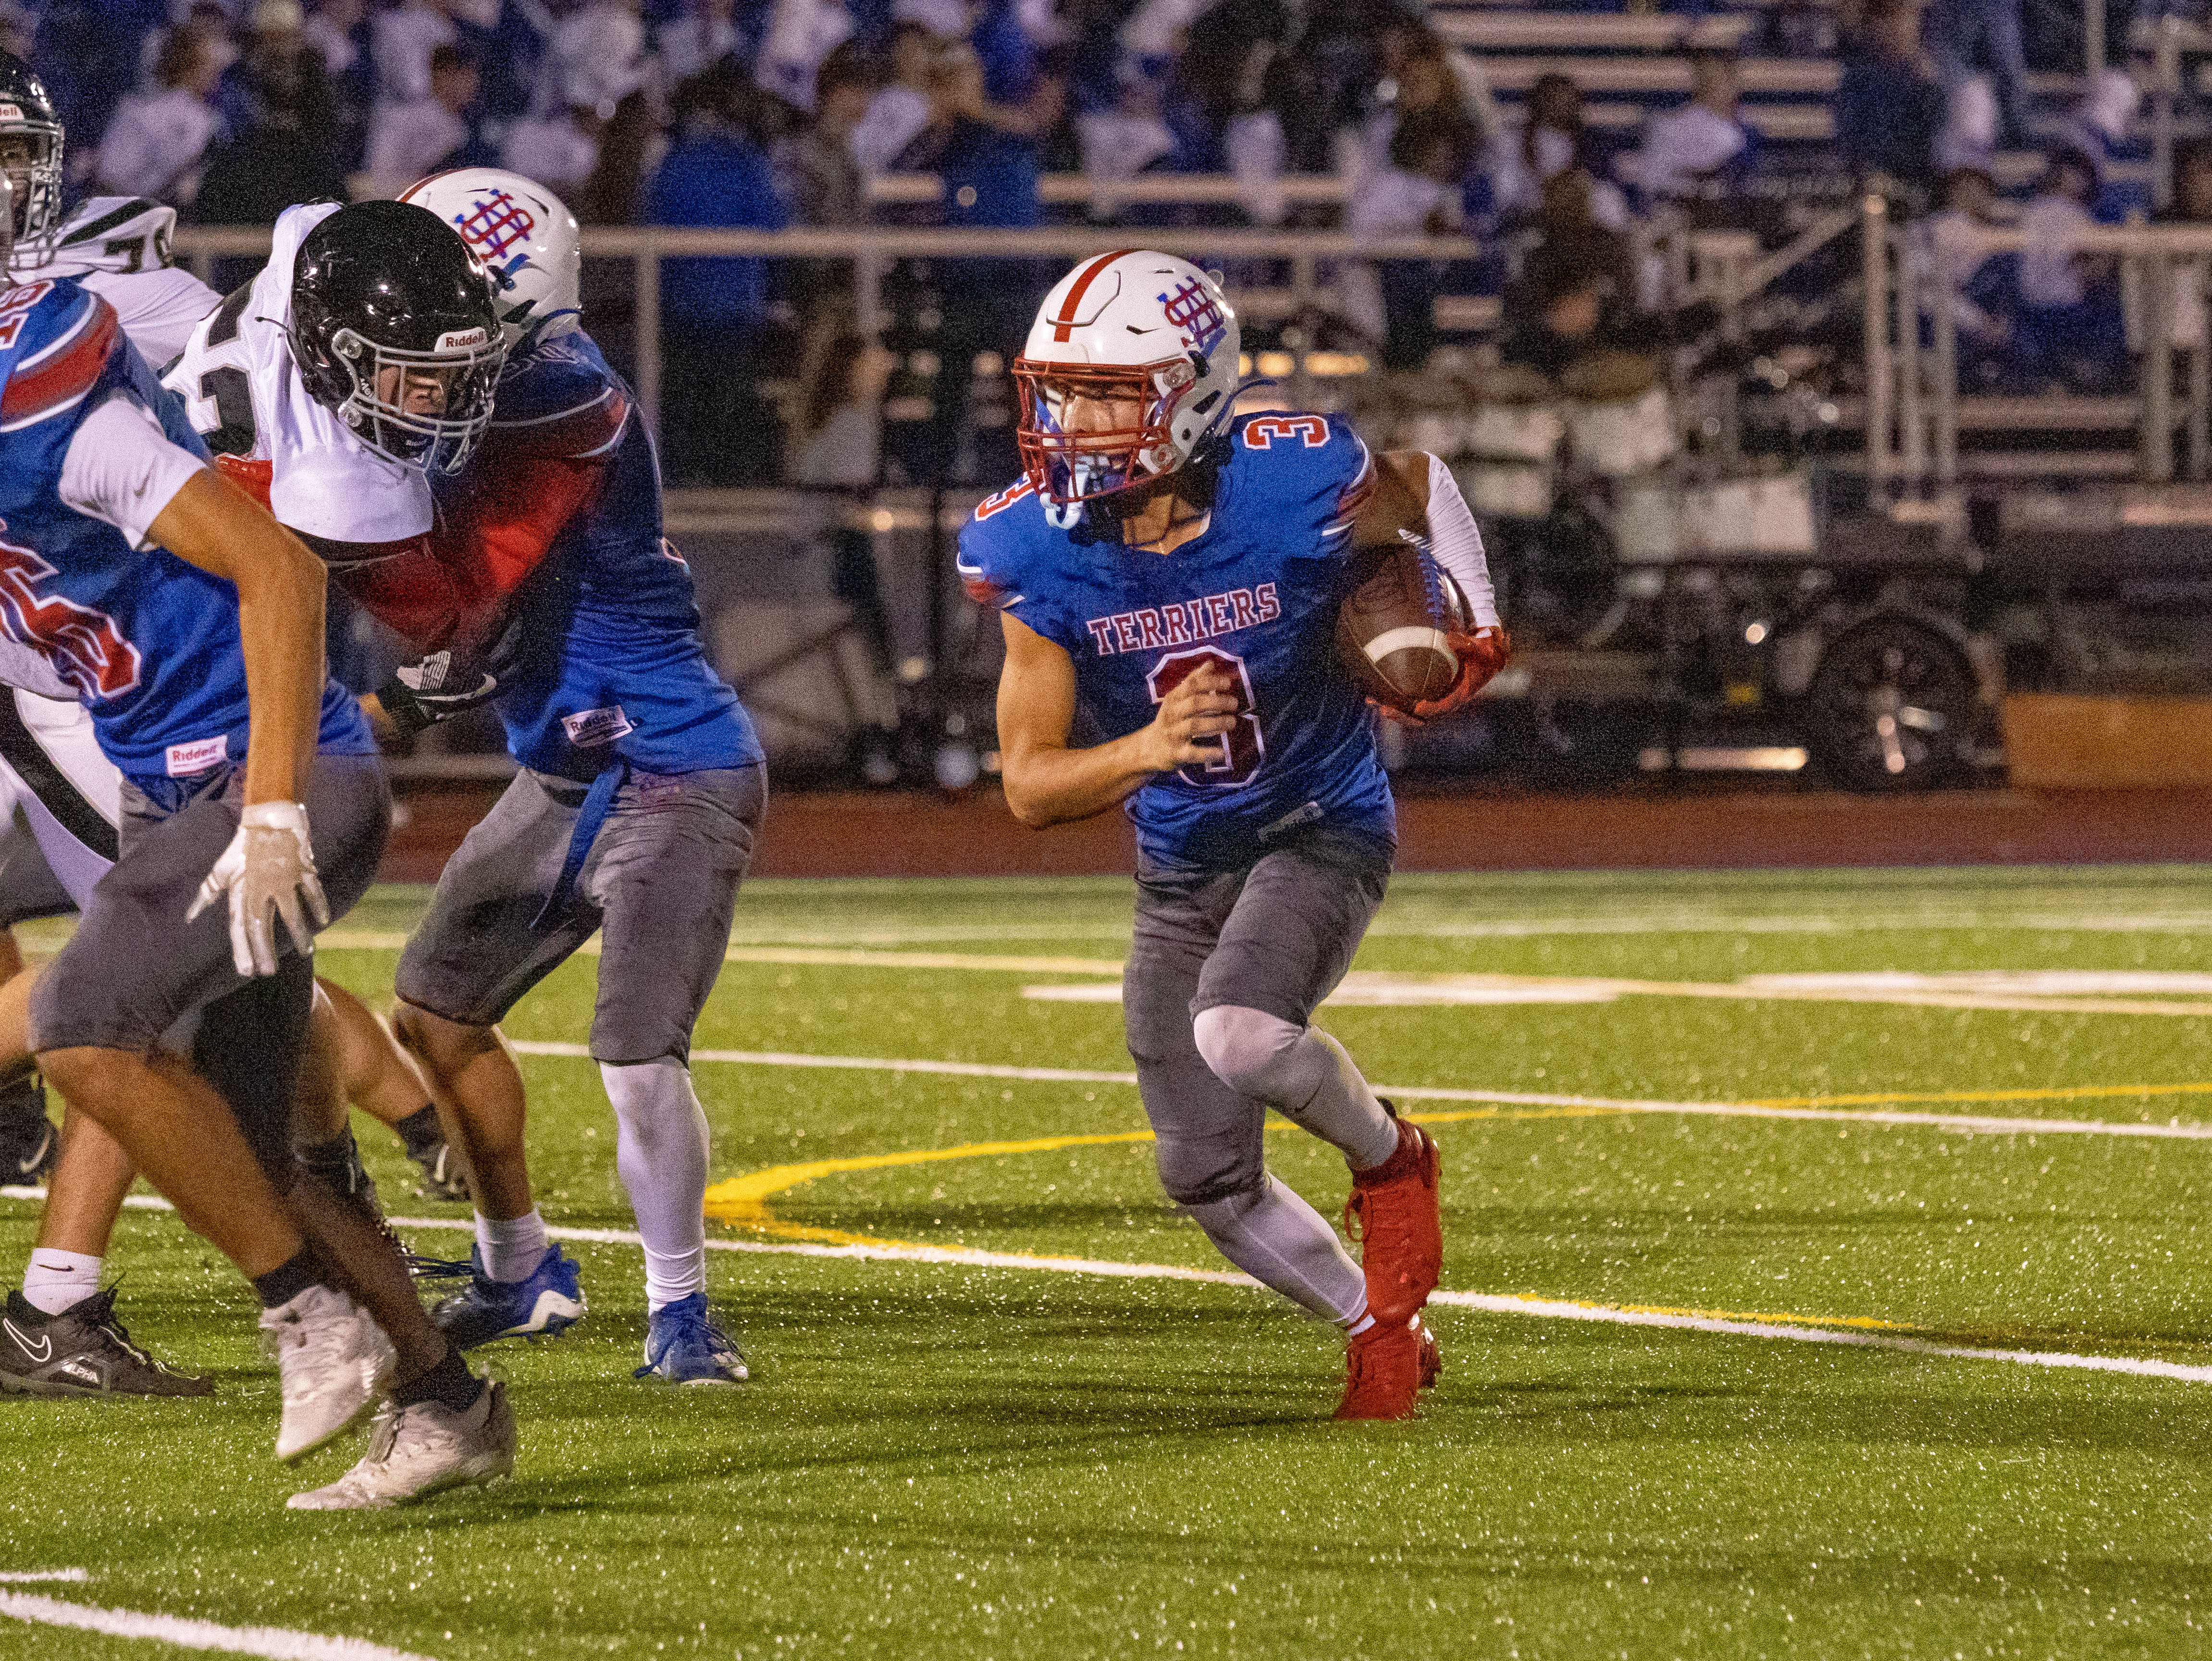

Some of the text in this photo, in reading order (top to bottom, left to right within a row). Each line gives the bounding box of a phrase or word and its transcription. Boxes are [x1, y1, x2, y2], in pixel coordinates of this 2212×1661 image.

[445, 331, 484, 347] Riddell
[1243, 415, 1330, 449] 3
[1087, 582, 1281, 656] TERRIERS
[570, 712, 617, 732] Riddell
[172, 744, 217, 763] Riddell
[62, 1363, 100, 1384] ALPHA
